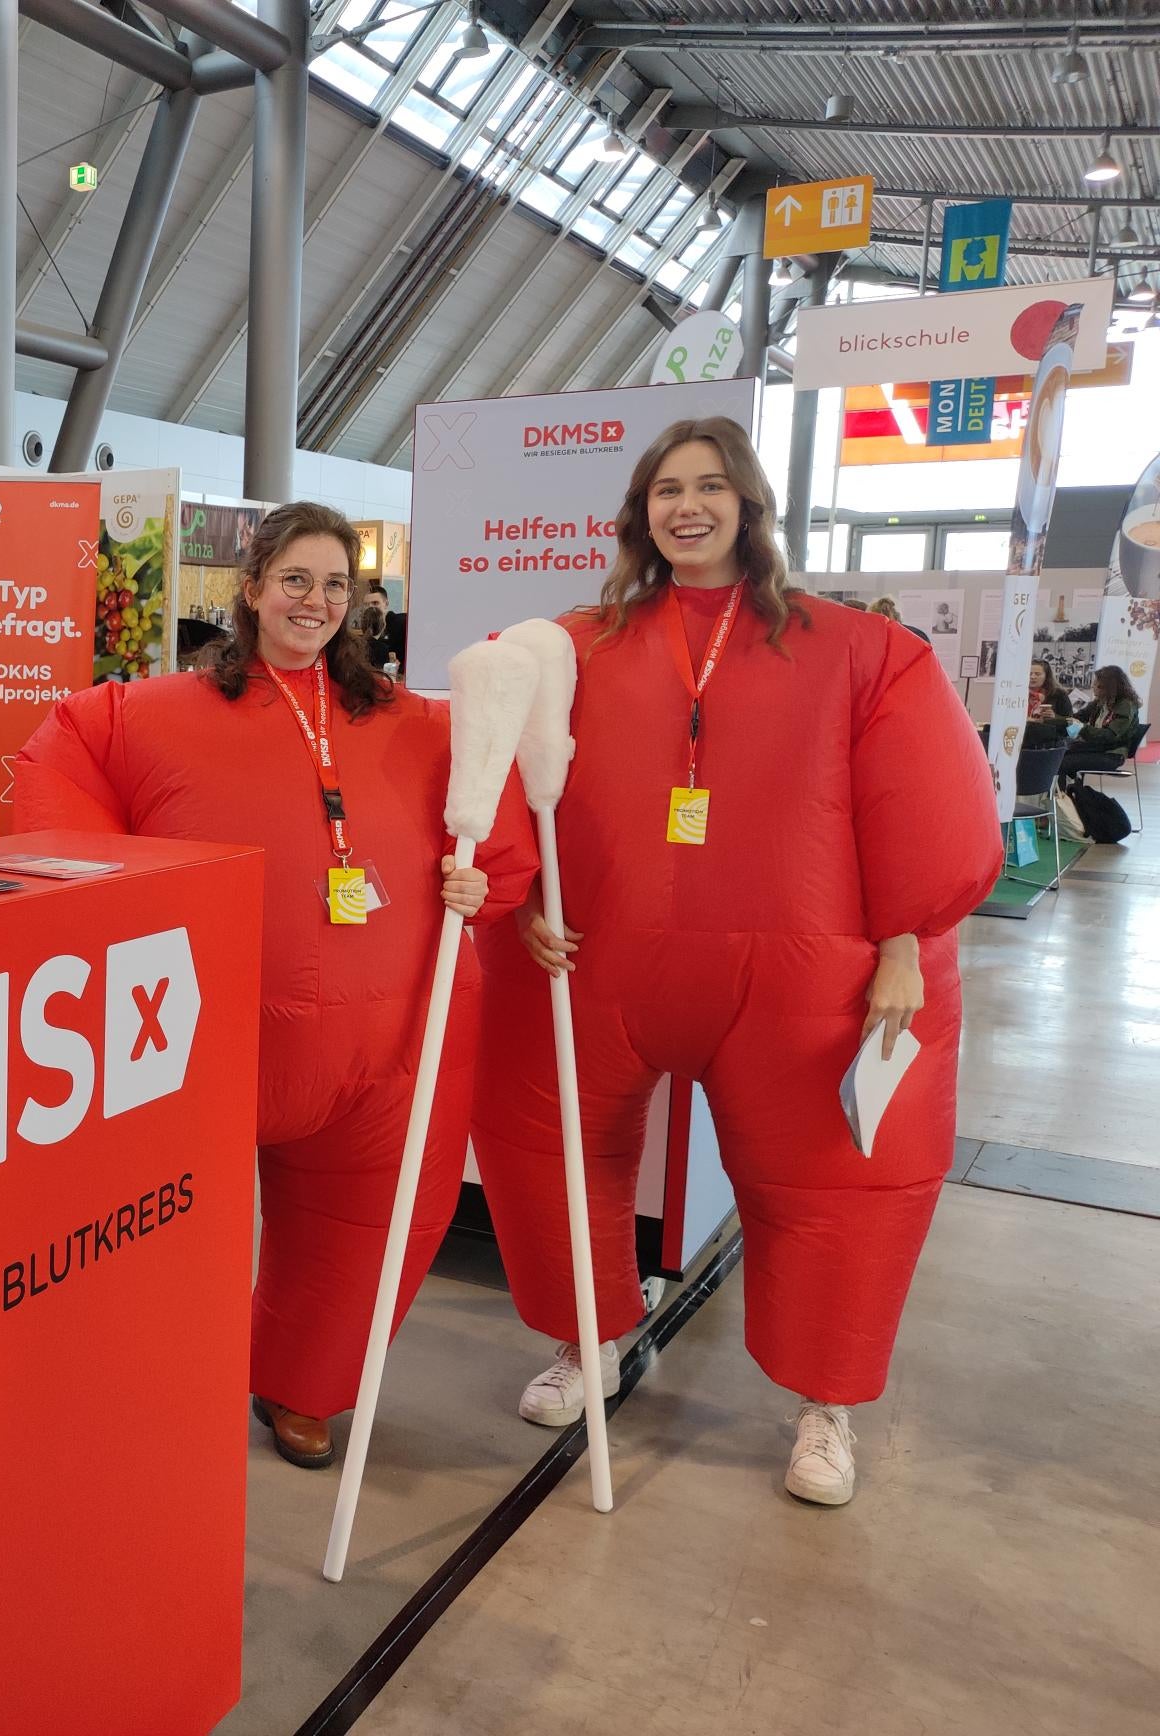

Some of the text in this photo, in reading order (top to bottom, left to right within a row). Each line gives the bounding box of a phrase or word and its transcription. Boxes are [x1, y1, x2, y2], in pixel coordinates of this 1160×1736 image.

[838, 325, 970, 353] blickschule
[936, 383, 956, 433] MON
[967, 377, 987, 432] DEUT
[523, 422, 600, 448] DKMS
[523, 445, 624, 458] WIR BESIEGEN BLUTKREBS
[113, 494, 138, 505] GEPA
[484, 516, 577, 541] Helfen
[459, 547, 607, 573] so einfach
[2, 1172, 194, 1313] BLUTKREBS
